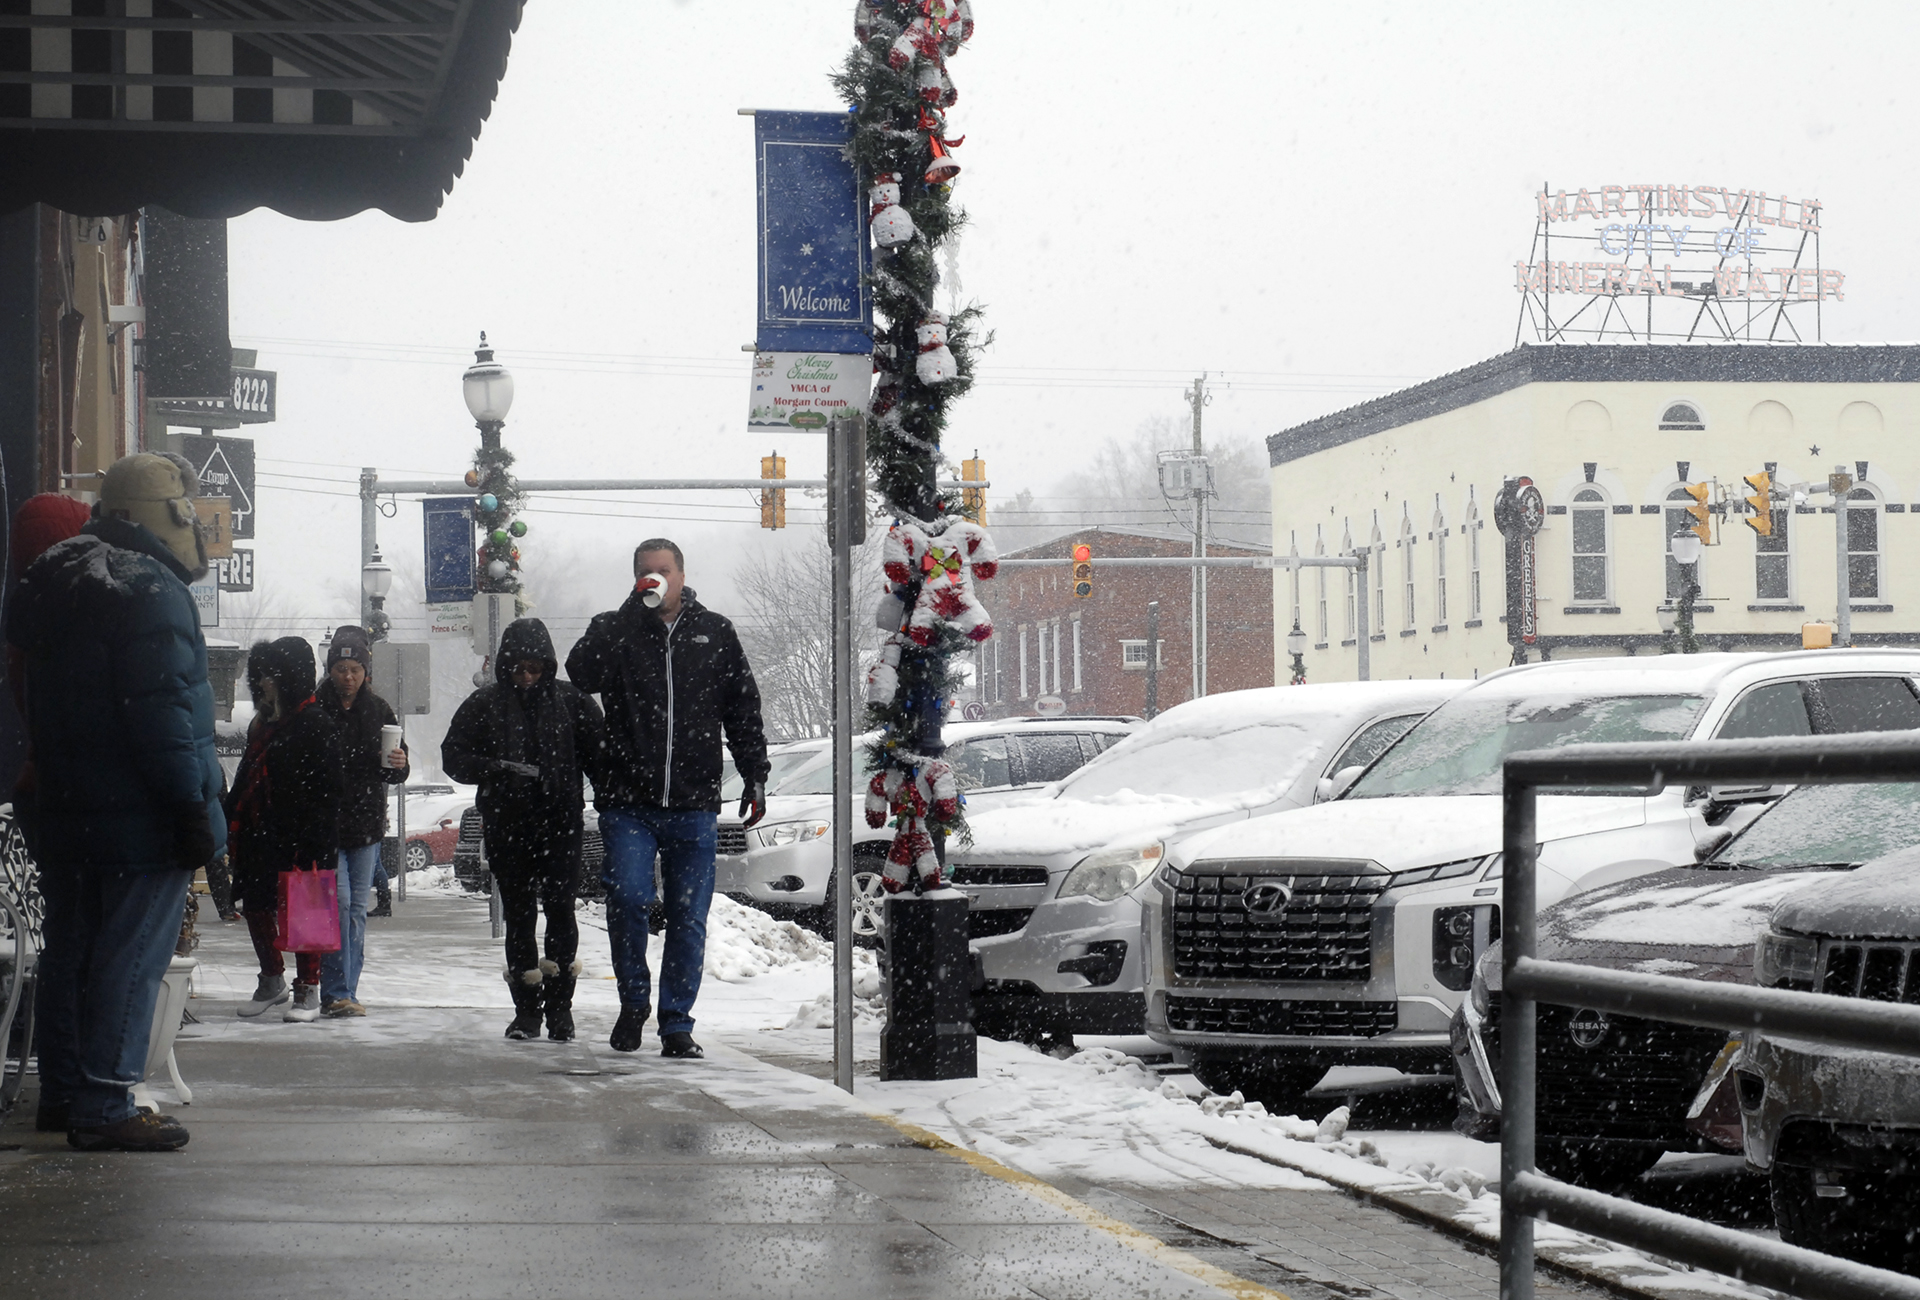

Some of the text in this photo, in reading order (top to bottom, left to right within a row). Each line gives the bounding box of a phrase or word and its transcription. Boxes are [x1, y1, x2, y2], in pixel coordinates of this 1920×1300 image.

[1536, 184, 1822, 233] MARTINSVILLE
[1600, 224, 1765, 259] CITY OF
[1516, 260, 1846, 301] MINERAL WATER
[778, 285, 851, 312] Welcome
[795, 355, 833, 371] Merry
[787, 367, 838, 380] Christmas
[234, 377, 268, 412] 8222
[791, 384, 831, 393] YMCA of
[774, 397, 848, 407] Morgan County
[431, 625, 450, 633] Prince
[1569, 1022, 1609, 1030] NISSAN
